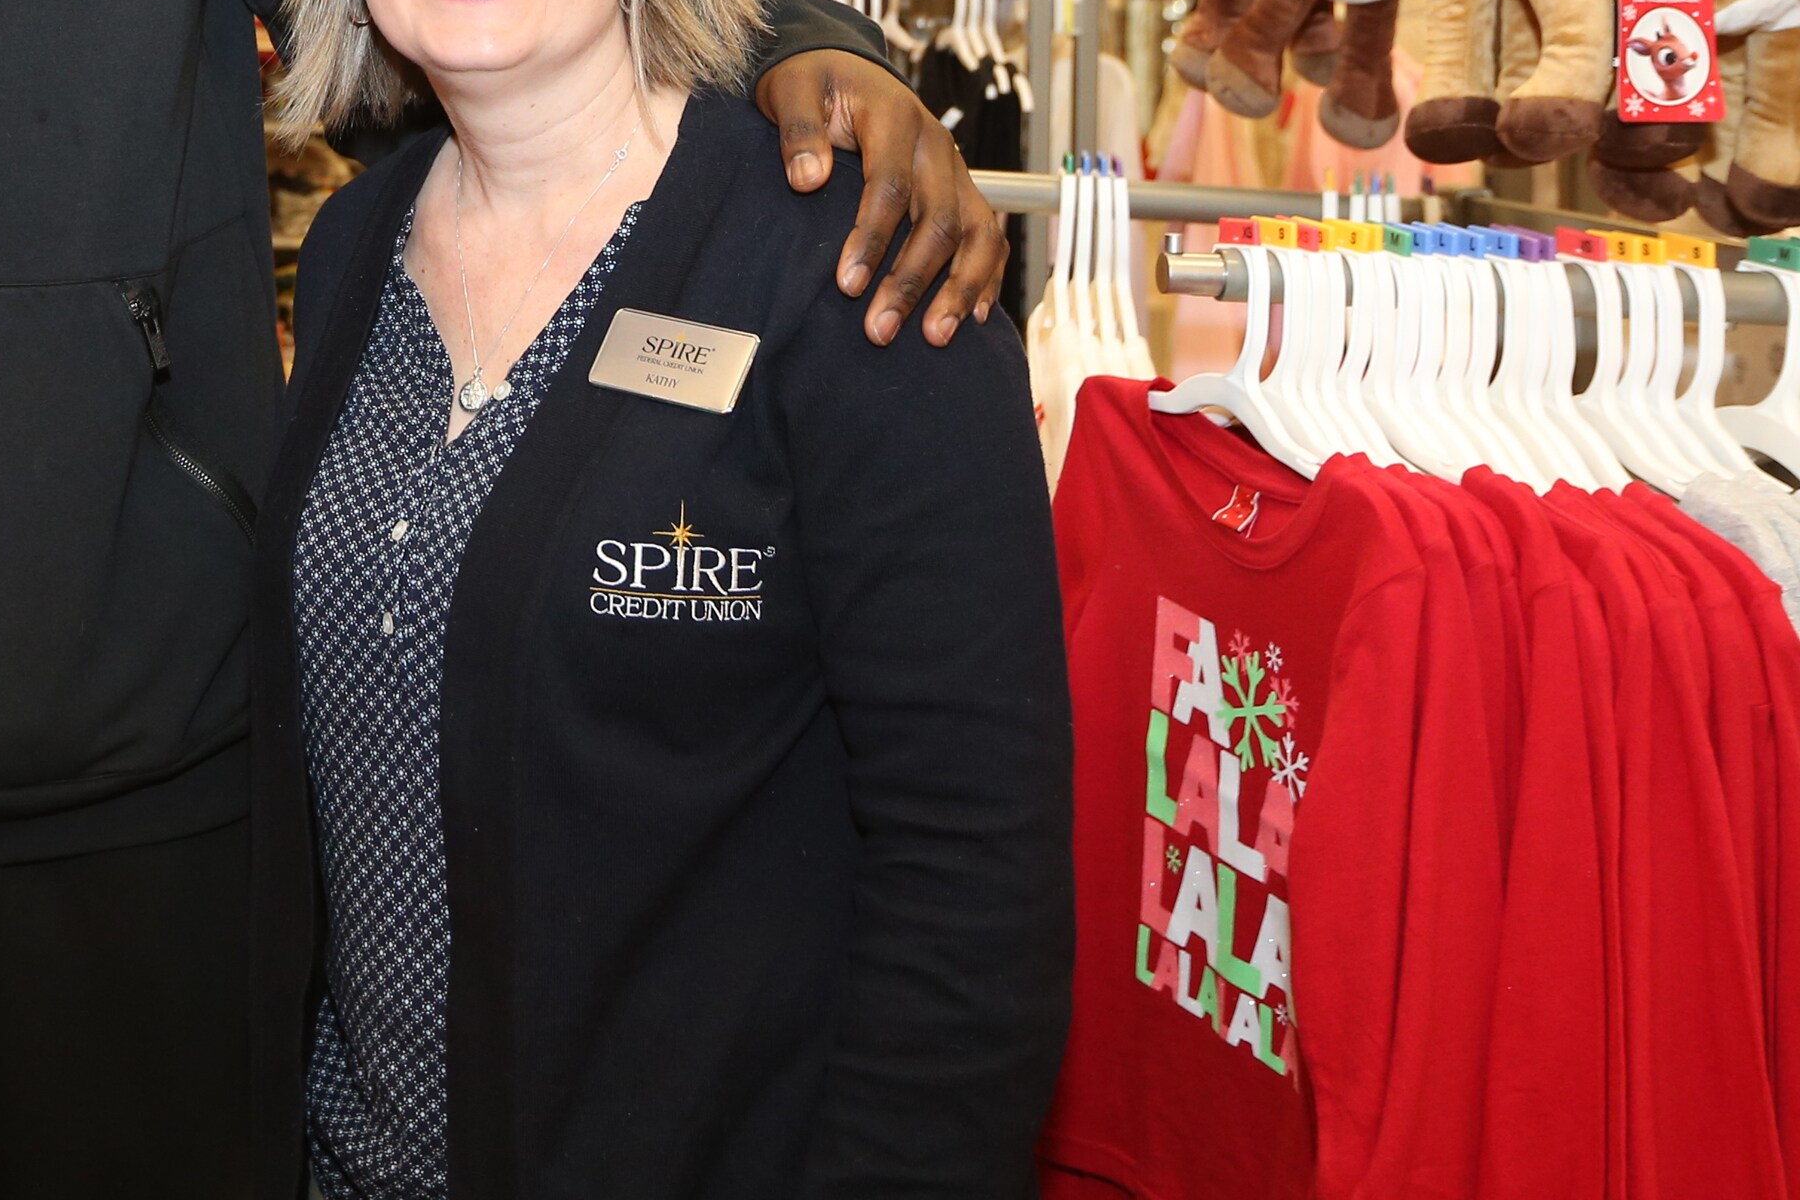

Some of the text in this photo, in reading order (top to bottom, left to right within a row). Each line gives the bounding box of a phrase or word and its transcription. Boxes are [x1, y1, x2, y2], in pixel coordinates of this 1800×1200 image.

[637, 354, 704, 375] FEDERAL CREDIT UNION
[642, 335, 711, 365] SPIRE
[645, 373, 679, 388] KATHY
[592, 539, 763, 595] SPIRE
[590, 592, 763, 621] CREDIT UNION
[1151, 595, 1230, 748] FA
